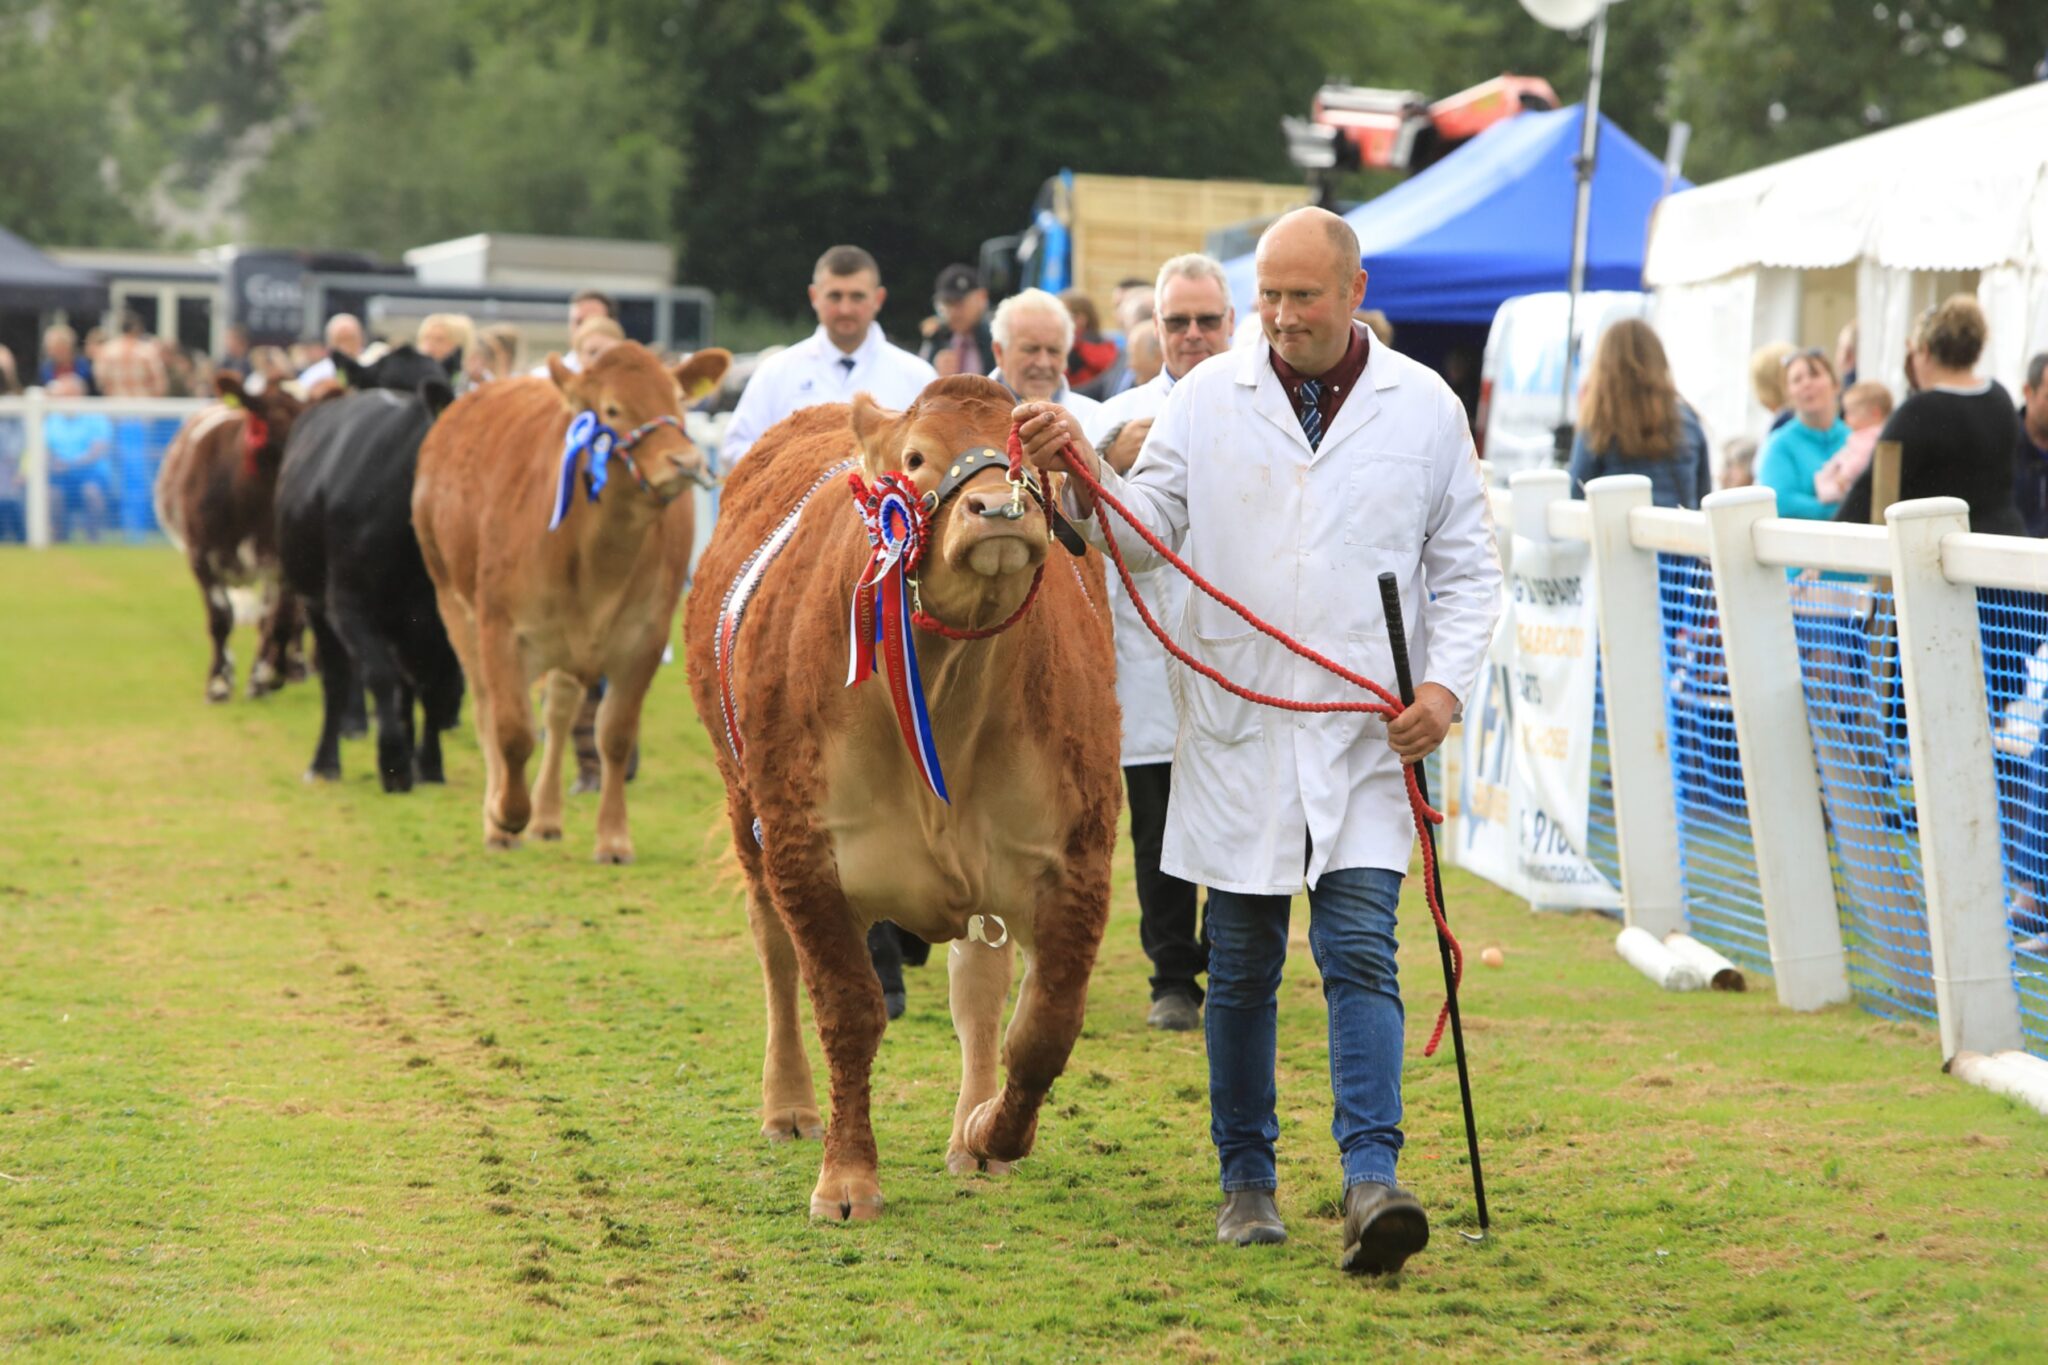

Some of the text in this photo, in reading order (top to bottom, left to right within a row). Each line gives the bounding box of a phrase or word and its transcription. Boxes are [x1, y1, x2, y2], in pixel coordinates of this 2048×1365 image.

[859, 579, 872, 645] CHAMPION
[888, 611, 899, 659] OVERALL
[893, 661, 906, 711] CHAMPION
